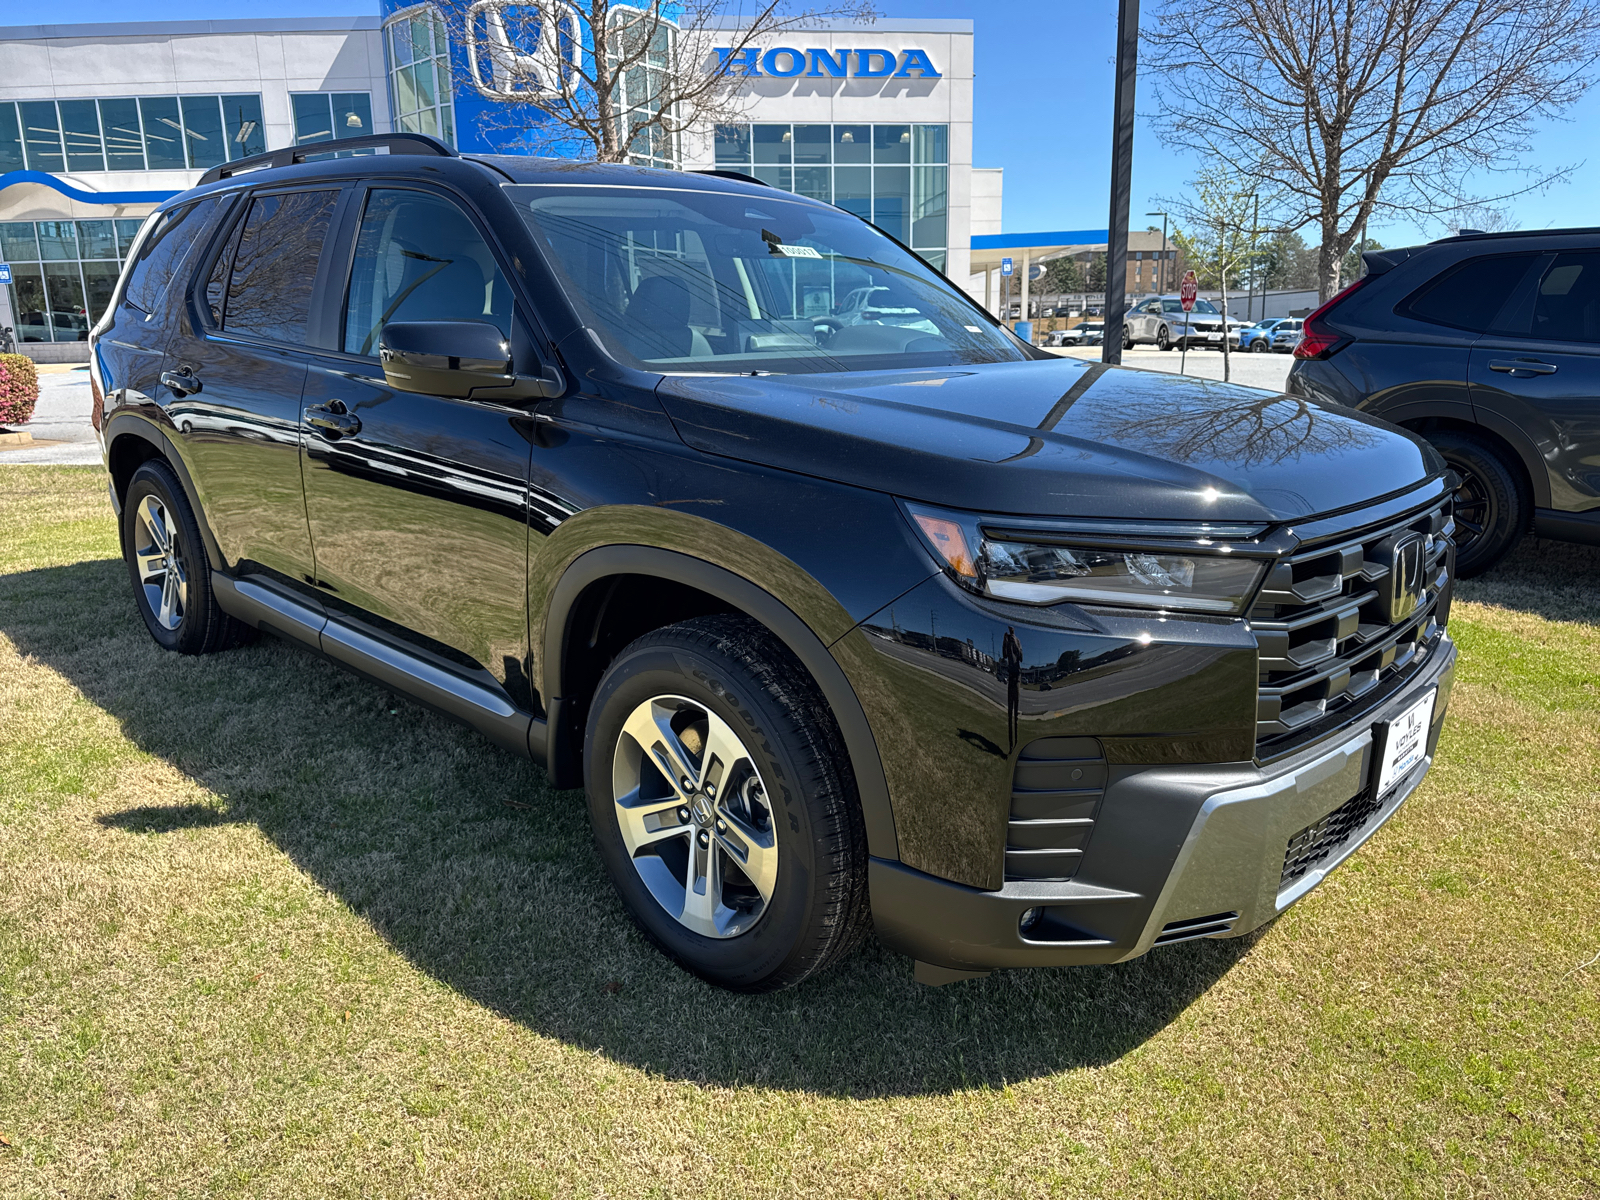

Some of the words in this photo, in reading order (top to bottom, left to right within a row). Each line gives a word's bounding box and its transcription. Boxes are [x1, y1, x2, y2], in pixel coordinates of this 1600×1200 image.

[713, 47, 943, 77] HONDA
[1181, 283, 1197, 299] STOP
[1396, 721, 1422, 750] VOYLES
[692, 669, 800, 834] GOODYEAR
